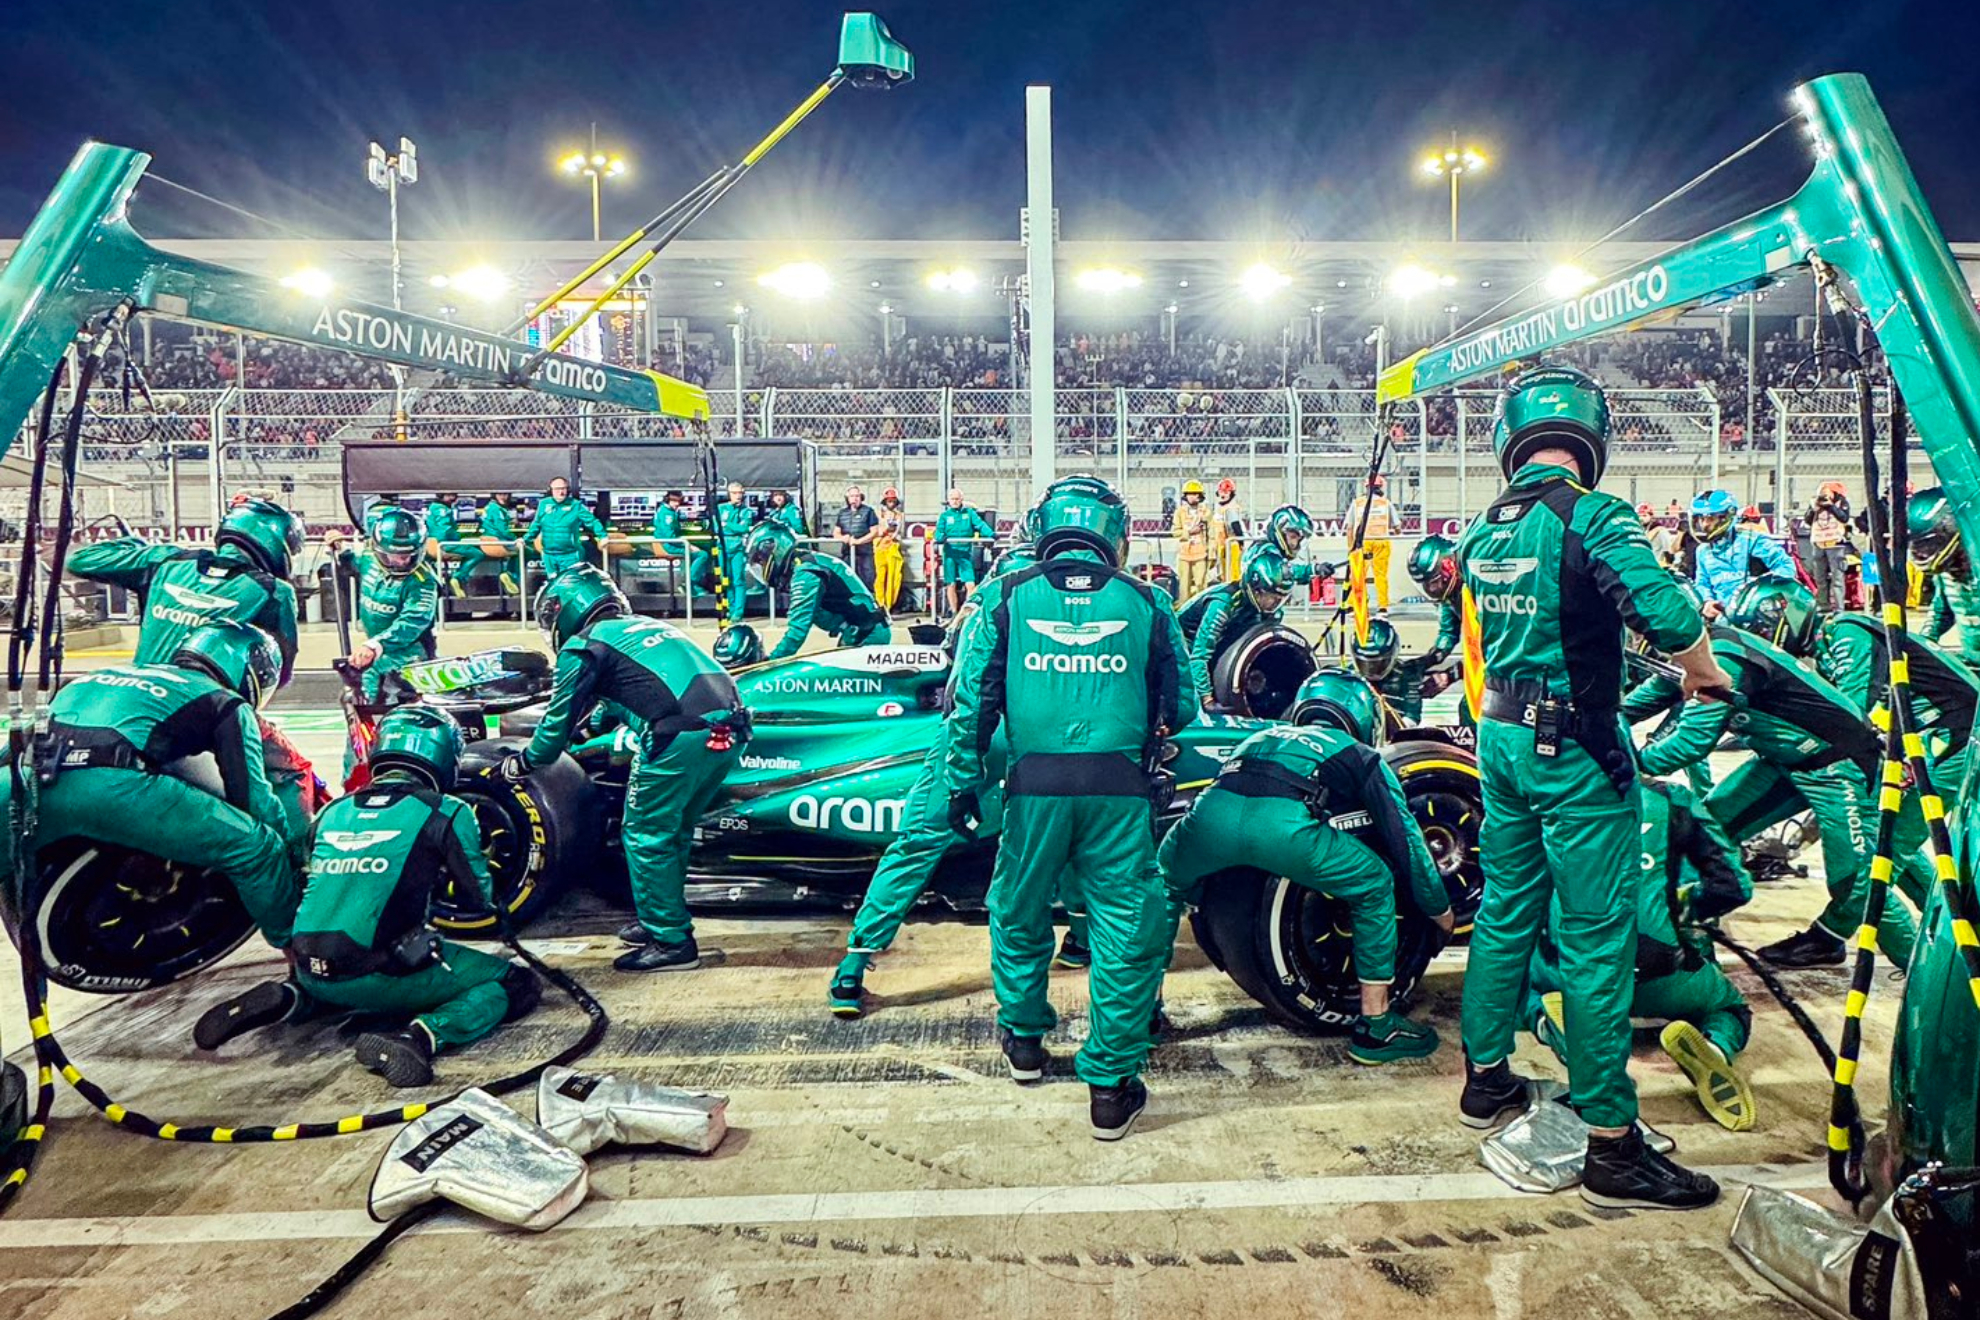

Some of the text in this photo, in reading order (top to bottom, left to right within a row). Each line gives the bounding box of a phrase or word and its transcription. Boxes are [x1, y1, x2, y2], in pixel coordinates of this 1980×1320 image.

[1563, 265, 1668, 331] aramco
[312, 306, 411, 355] ASTON
[419, 327, 511, 374] MARTIN
[1450, 311, 1558, 374] ASTON MARTIN
[1065, 596, 1091, 605] BOSS
[867, 652, 941, 665] MAADEN
[1024, 652, 1127, 673] aramco
[753, 679, 882, 693] ASTON MARTIN
[739, 756, 801, 770] Valvoline
[512, 785, 546, 845] ERO
[788, 794, 908, 832] aram
[417, 1122, 469, 1161] MAIN
[1862, 1243, 1885, 1312] SPARE
